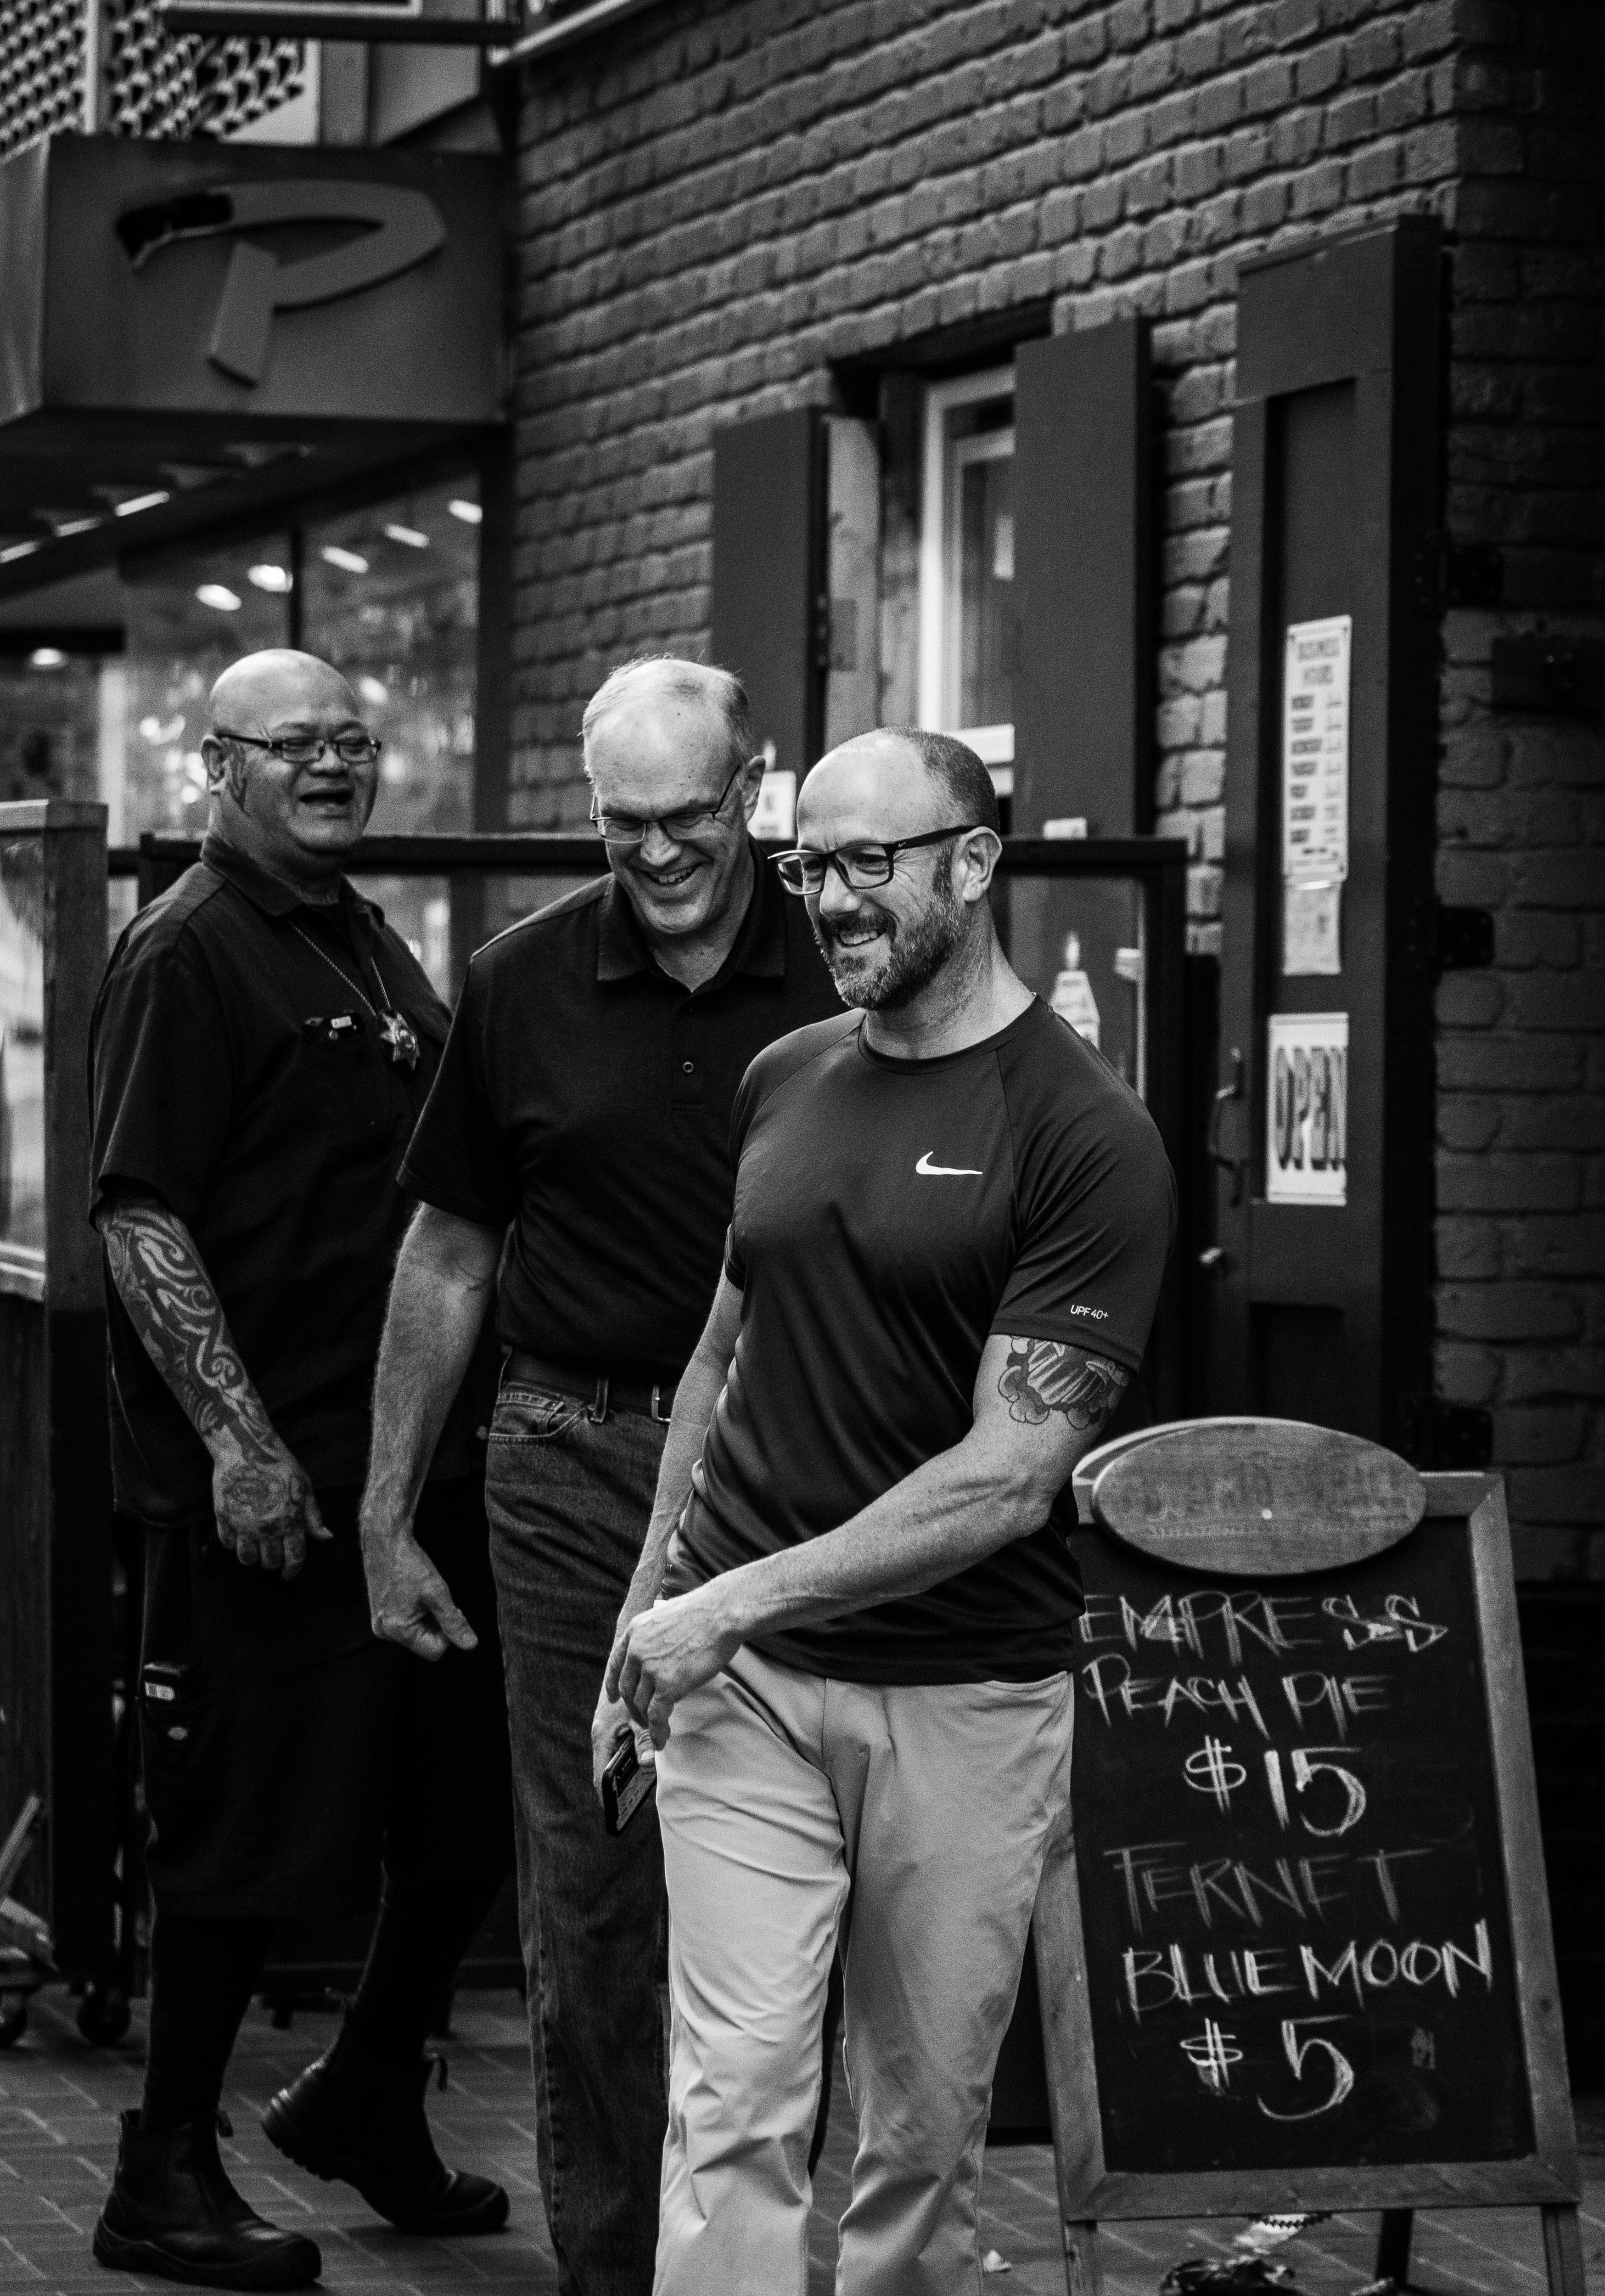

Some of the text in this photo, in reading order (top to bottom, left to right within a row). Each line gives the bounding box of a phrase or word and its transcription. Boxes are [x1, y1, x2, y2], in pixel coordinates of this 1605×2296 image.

[1079, 1589, 1448, 1666] EMPRESS
[1082, 1653, 1393, 1742] PEACH PIE
[1121, 1919, 1492, 2025] BLUE MOON
